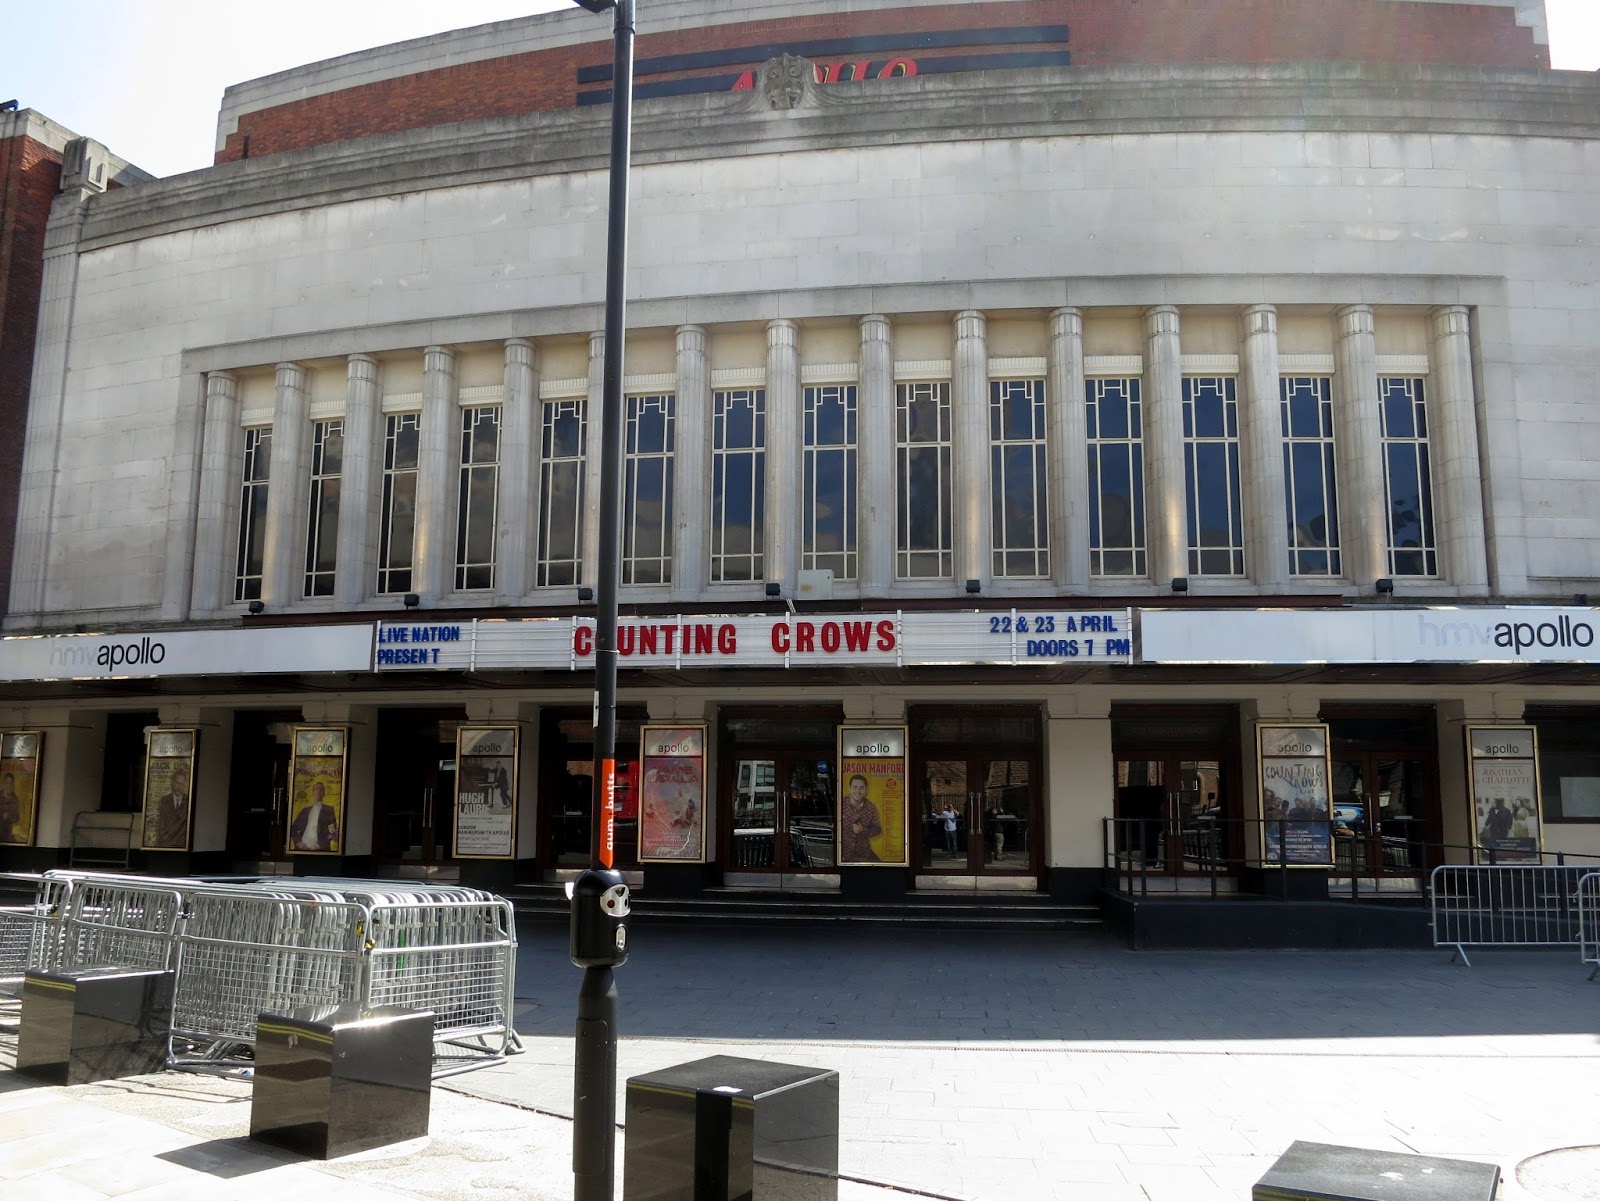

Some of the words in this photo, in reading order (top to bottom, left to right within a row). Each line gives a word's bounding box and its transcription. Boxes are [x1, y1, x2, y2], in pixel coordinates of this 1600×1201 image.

[990, 616, 1012, 633] 22
[1015, 616, 1029, 633] &
[1035, 616, 1055, 633] 23
[1067, 615, 1117, 632] APRIL
[379, 627, 408, 643] LIVE
[412, 626, 460, 642] NATION
[574, 624, 736, 656] CUNTING
[771, 620, 896, 653] CROWS
[1494, 615, 1593, 655] apollo
[1028, 639, 1079, 656] DOORS
[1084, 640, 1093, 656] 7
[1106, 639, 1130, 655] PM
[97, 637, 166, 672] apollo
[472, 743, 502, 754] apollo
[658, 743, 689, 754] apollo
[856, 743, 890, 755] apollo
[1277, 743, 1312, 754] apollo
[1485, 743, 1520, 756] apollo
[843, 763, 867, 774] JASON
[1265, 764, 1323, 779] COUNTING
[1482, 768, 1523, 777] JONATHAN
[1290, 777, 1323, 790] CROWS
[1482, 776, 1532, 785] CHARLOTTE
[604, 772, 615, 810] butts
[459, 792, 485, 804] HUGH
